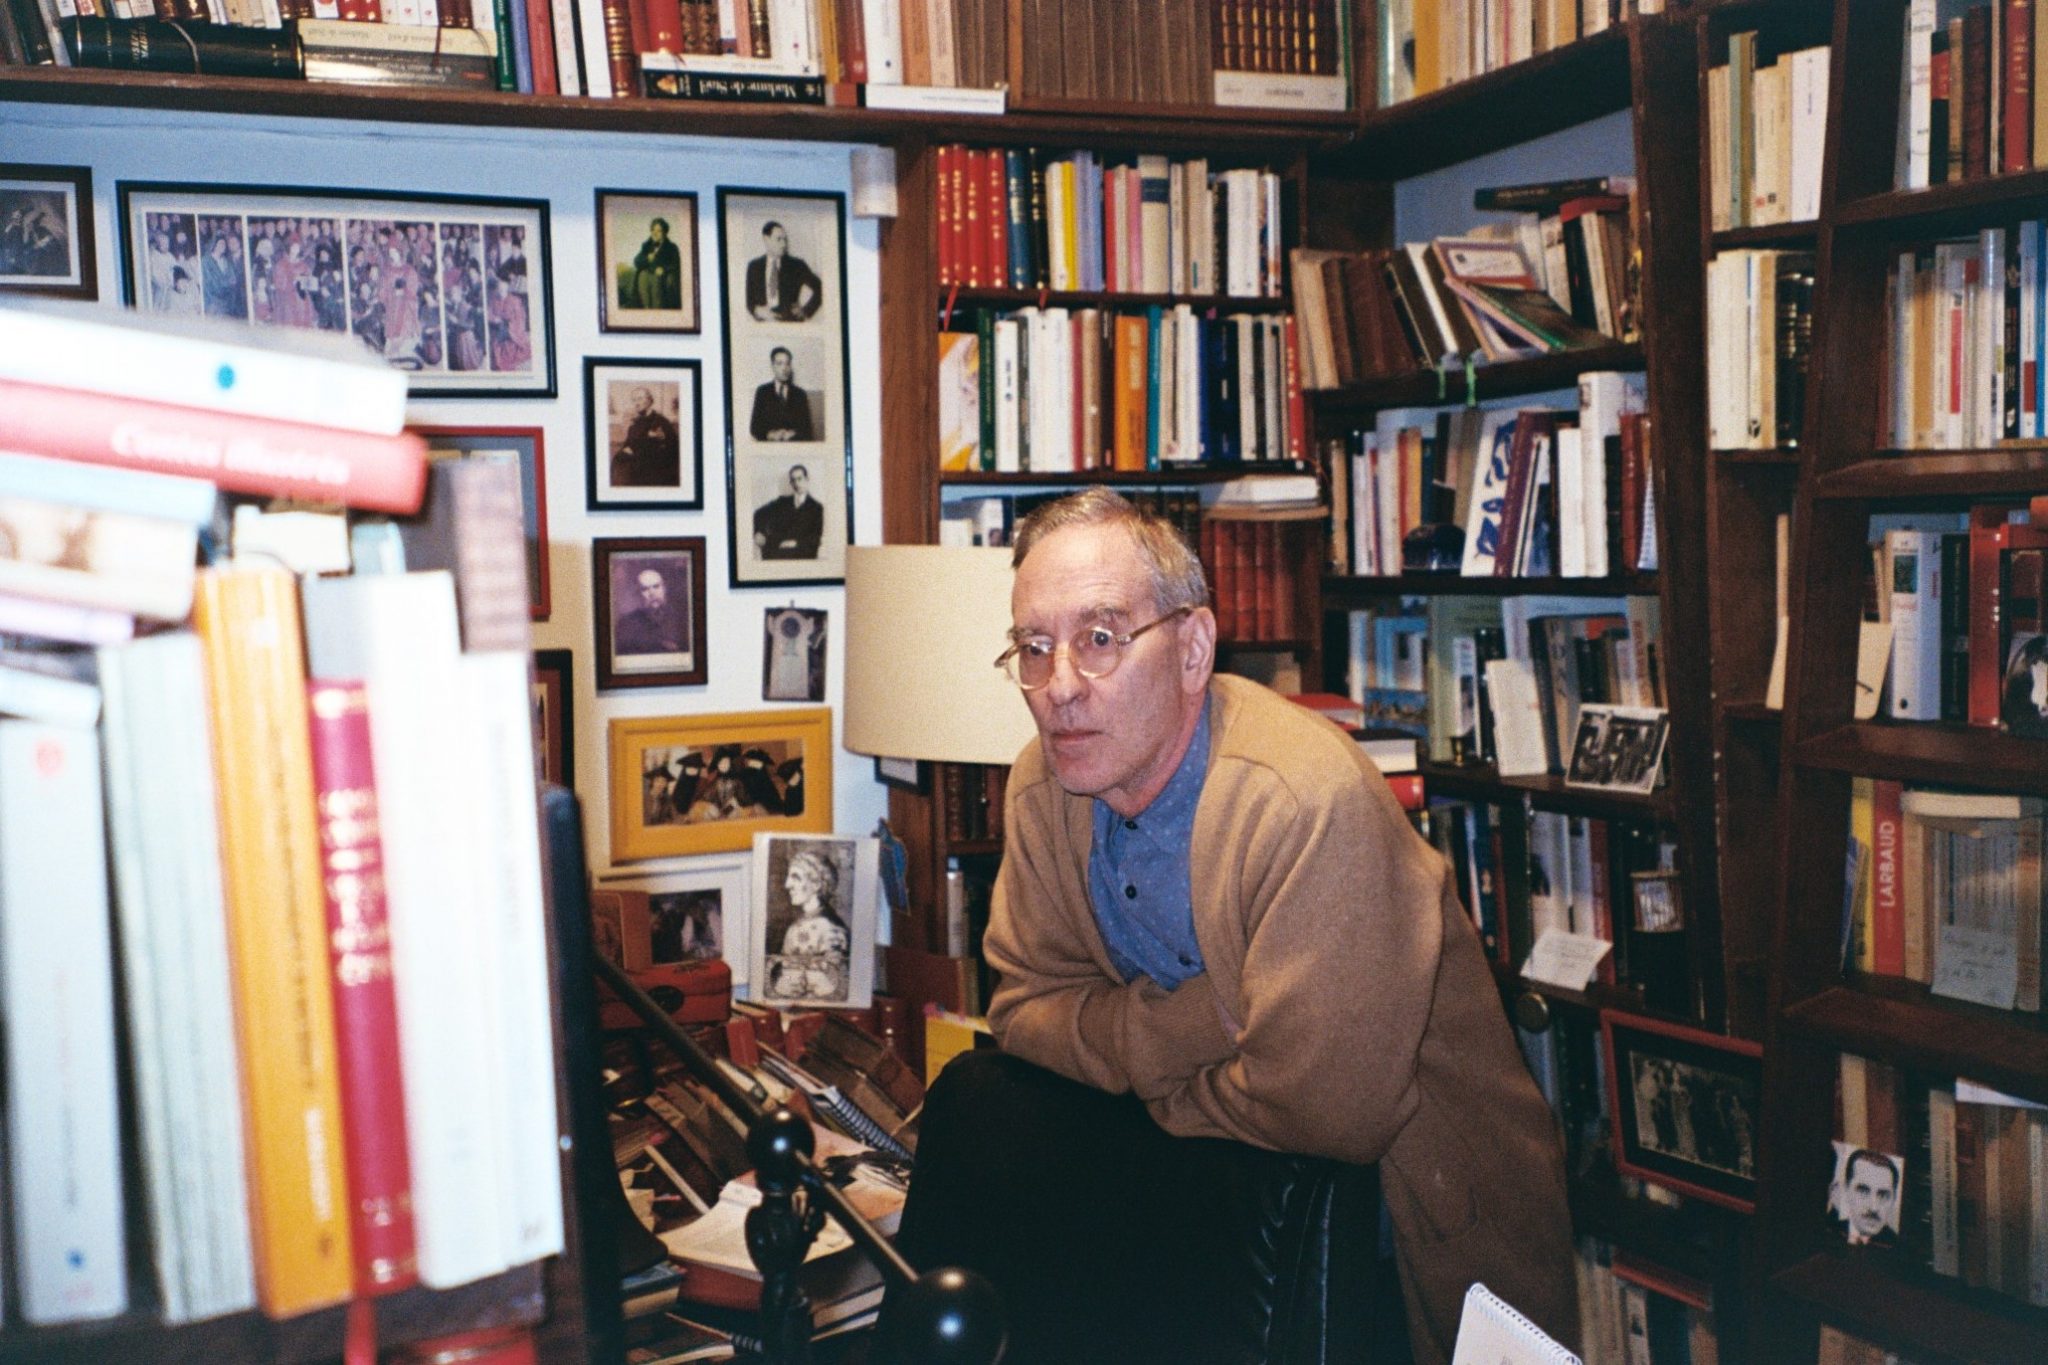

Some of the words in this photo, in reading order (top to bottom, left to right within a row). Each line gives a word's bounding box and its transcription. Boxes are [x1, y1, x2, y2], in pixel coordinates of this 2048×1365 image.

[700, 79, 728, 95] Staël
[730, 80, 744, 95] de
[747, 81, 797, 98] Madame
[1879, 821, 1896, 907] LARBAUD
